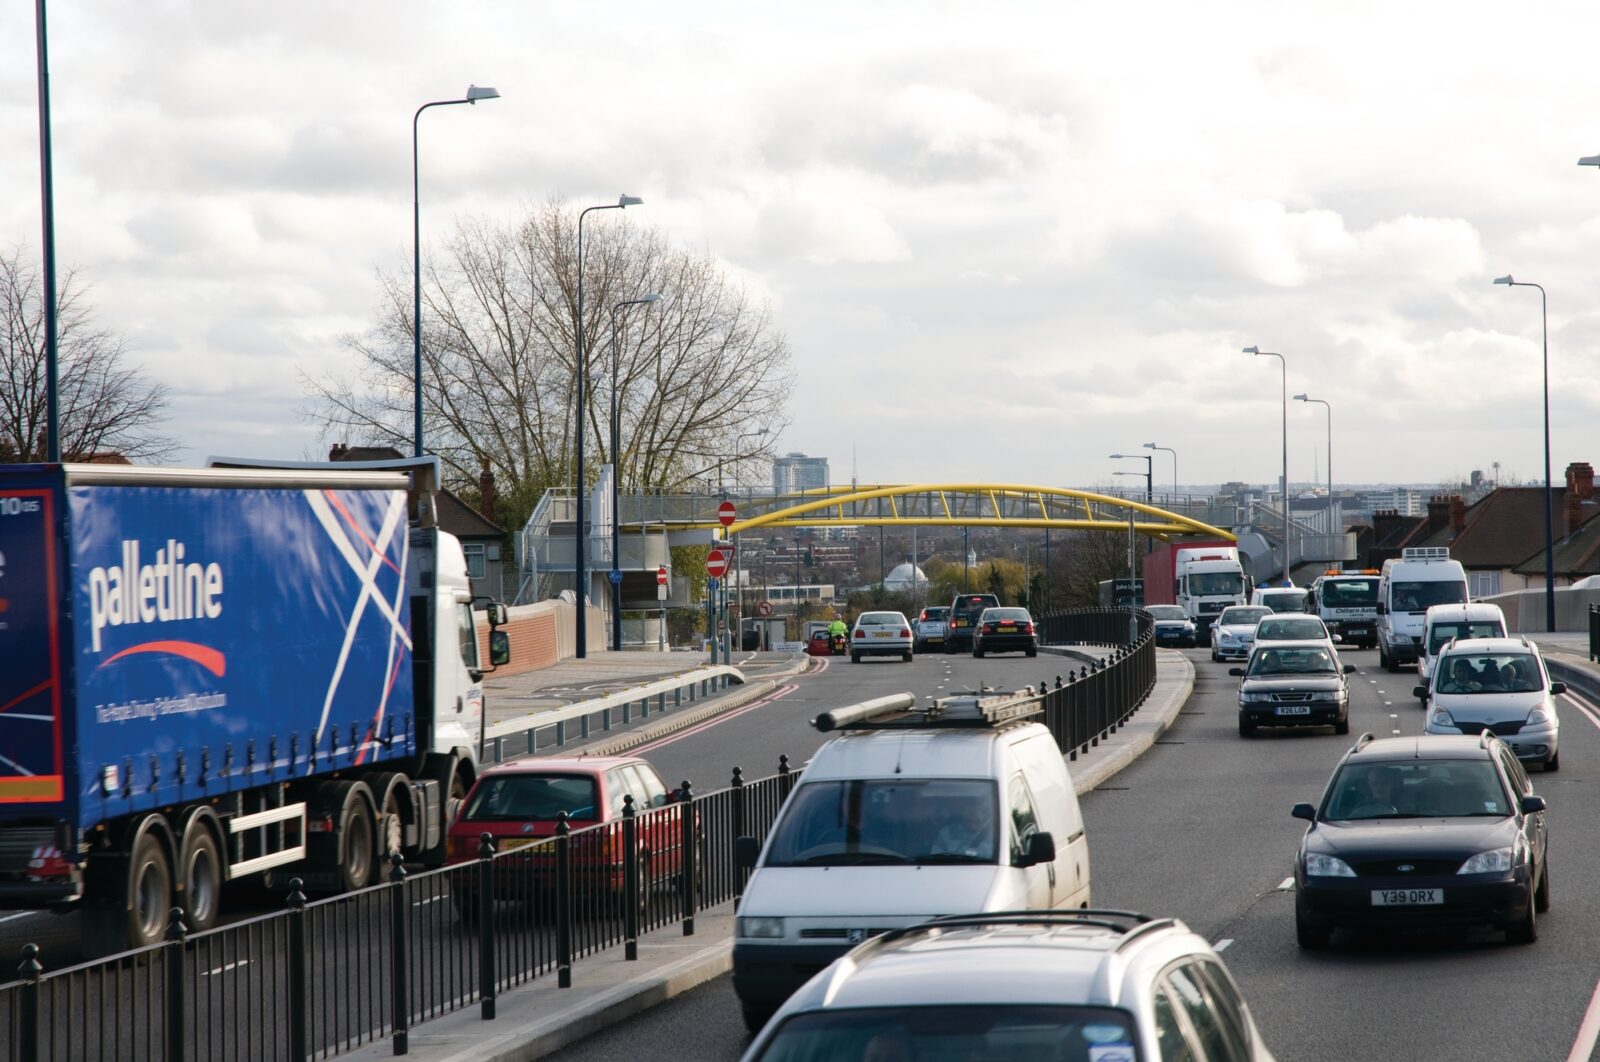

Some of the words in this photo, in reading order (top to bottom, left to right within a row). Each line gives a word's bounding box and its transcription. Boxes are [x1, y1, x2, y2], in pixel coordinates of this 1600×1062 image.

[89, 539, 224, 653] palletline
[1281, 706, 1293, 714] R26
[1382, 891, 1406, 903] Y39
[1410, 890, 1435, 903] ORX
